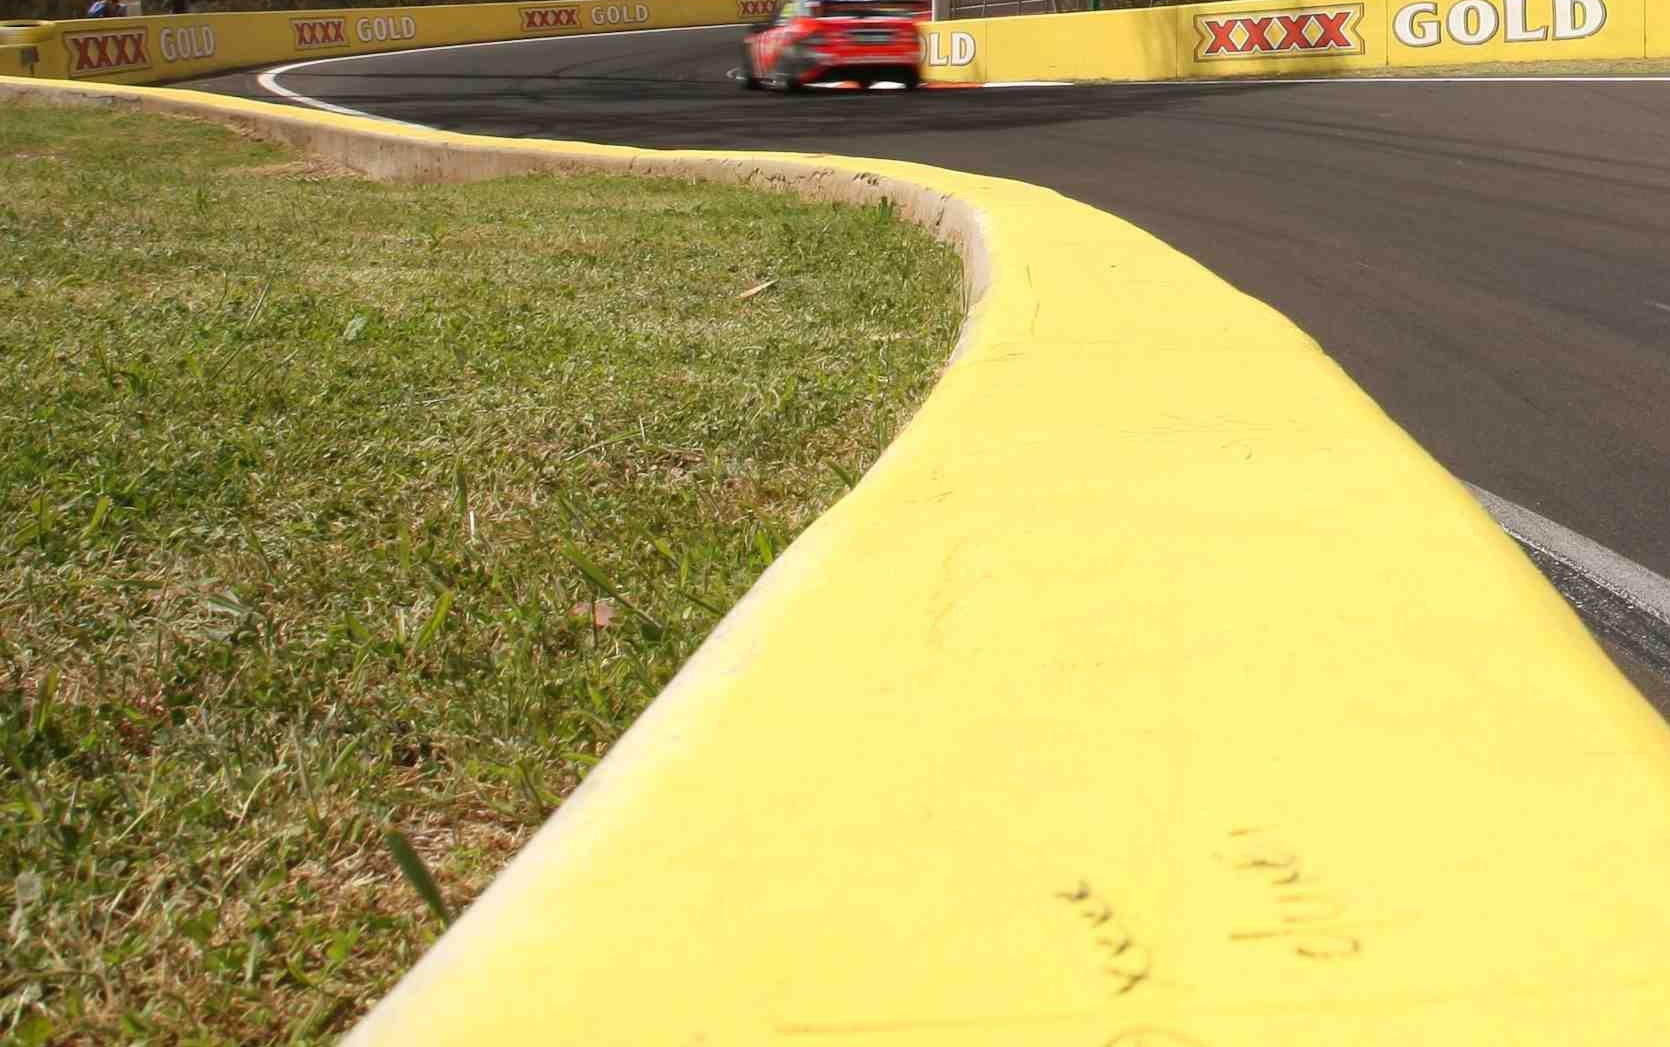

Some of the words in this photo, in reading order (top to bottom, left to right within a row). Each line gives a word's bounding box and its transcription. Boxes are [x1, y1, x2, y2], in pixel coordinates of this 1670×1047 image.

[294, 20, 345, 47] XXXX
[356, 16, 416, 42] GOLD
[525, 8, 577, 29] XXXX
[591, 4, 649, 25] GOLD
[1203, 9, 1358, 56] XXXX
[66, 33, 149, 72] XXXX
[160, 25, 216, 62] GOLD
[920, 31, 976, 67] LD
